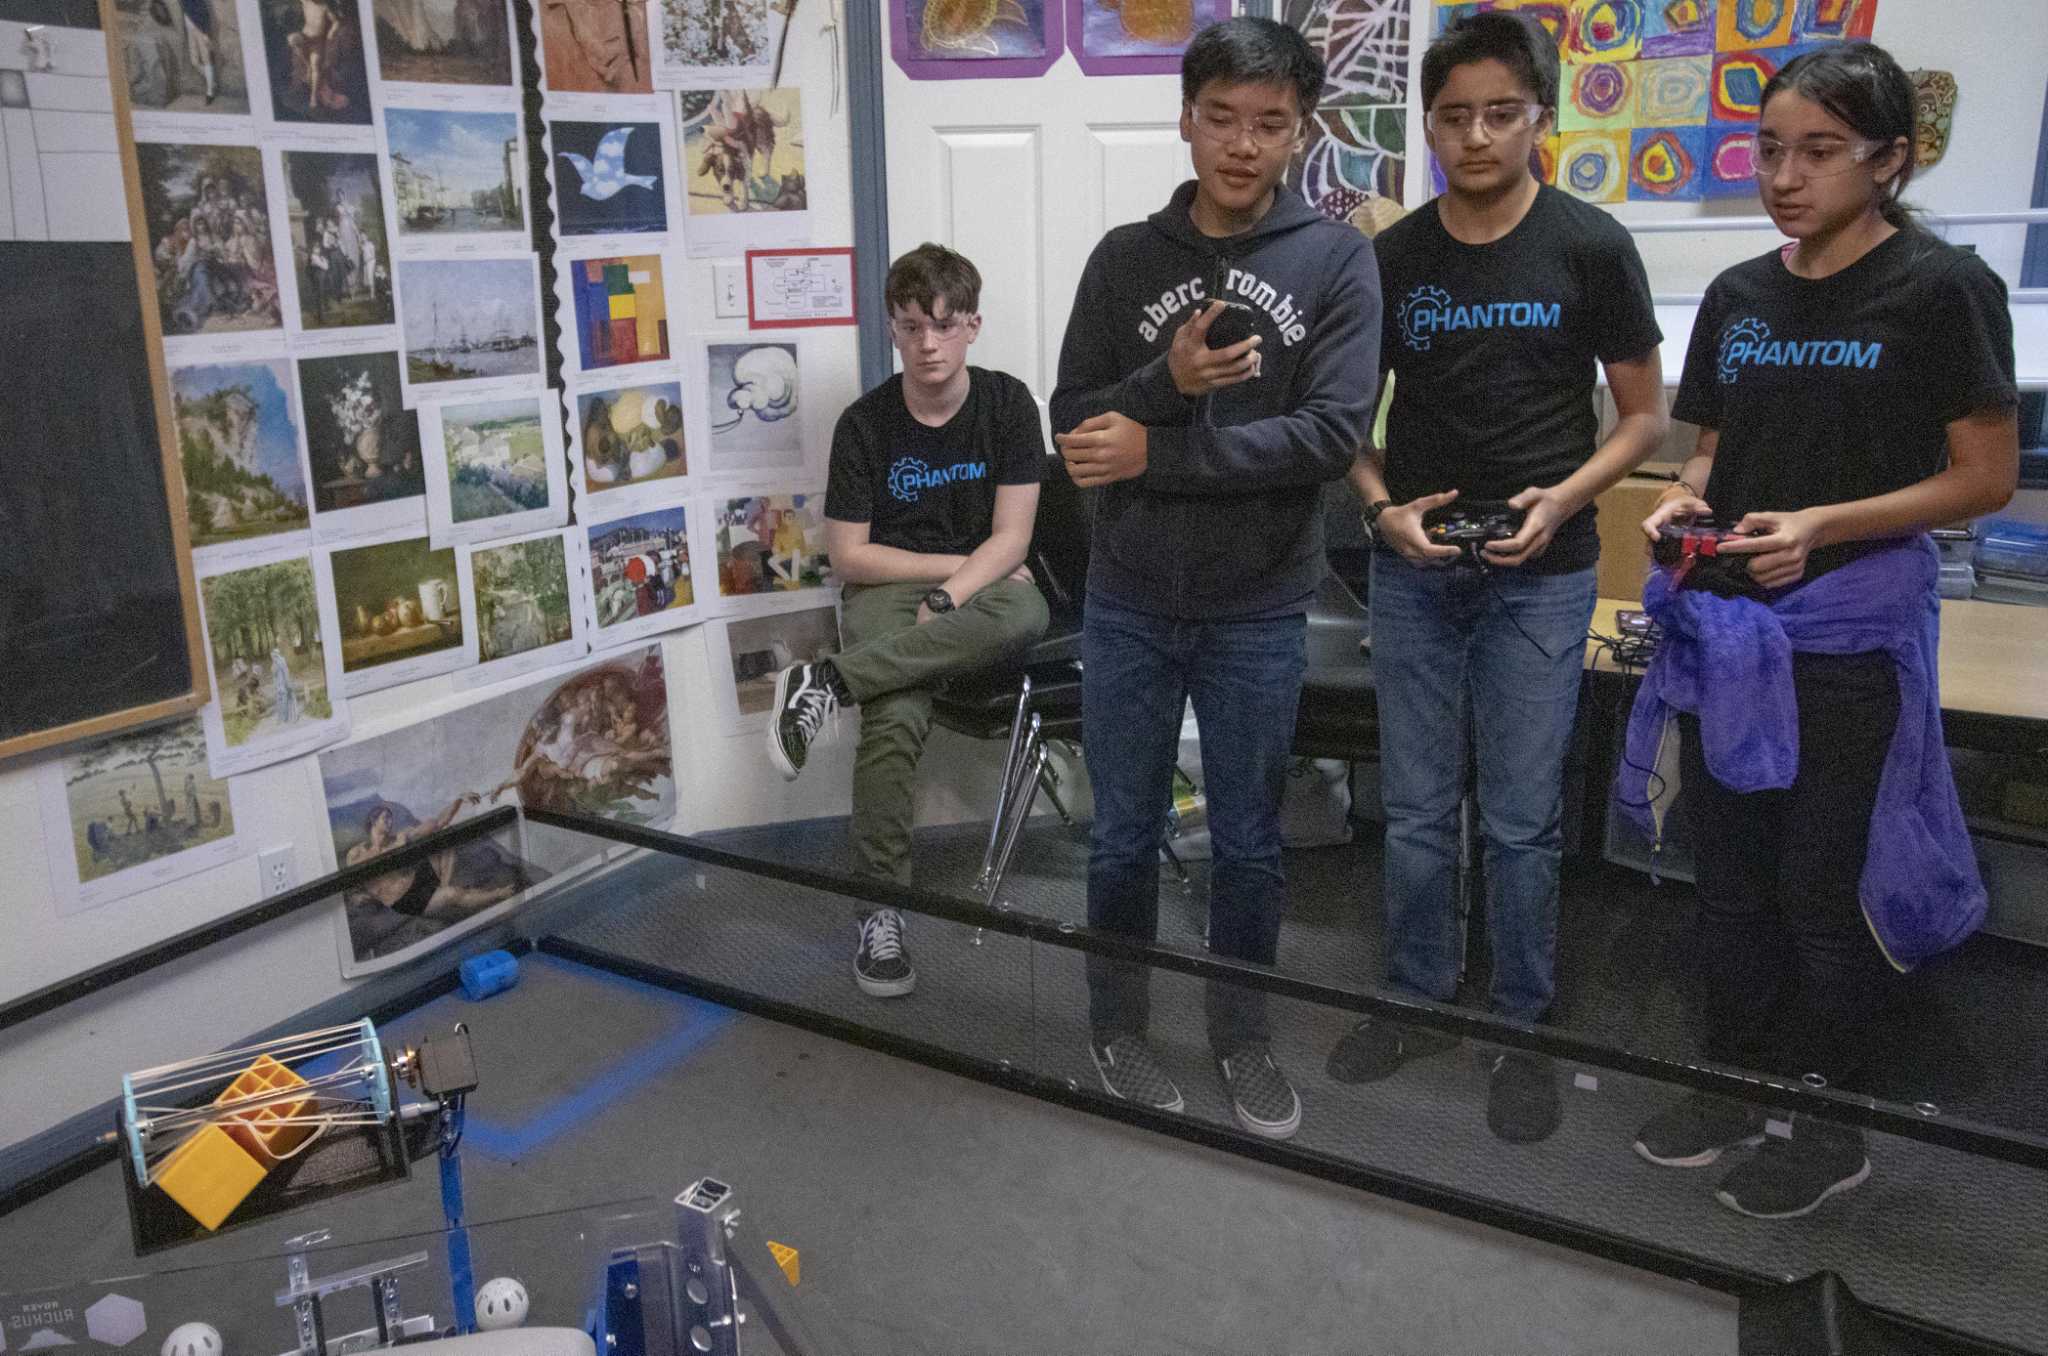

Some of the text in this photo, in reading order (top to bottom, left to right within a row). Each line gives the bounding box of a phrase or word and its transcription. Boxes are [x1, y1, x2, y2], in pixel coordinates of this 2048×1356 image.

[1413, 302, 1561, 333] PHANTOM
[1726, 340, 1883, 369] PHANTOM
[902, 462, 987, 490] PHANTOM
